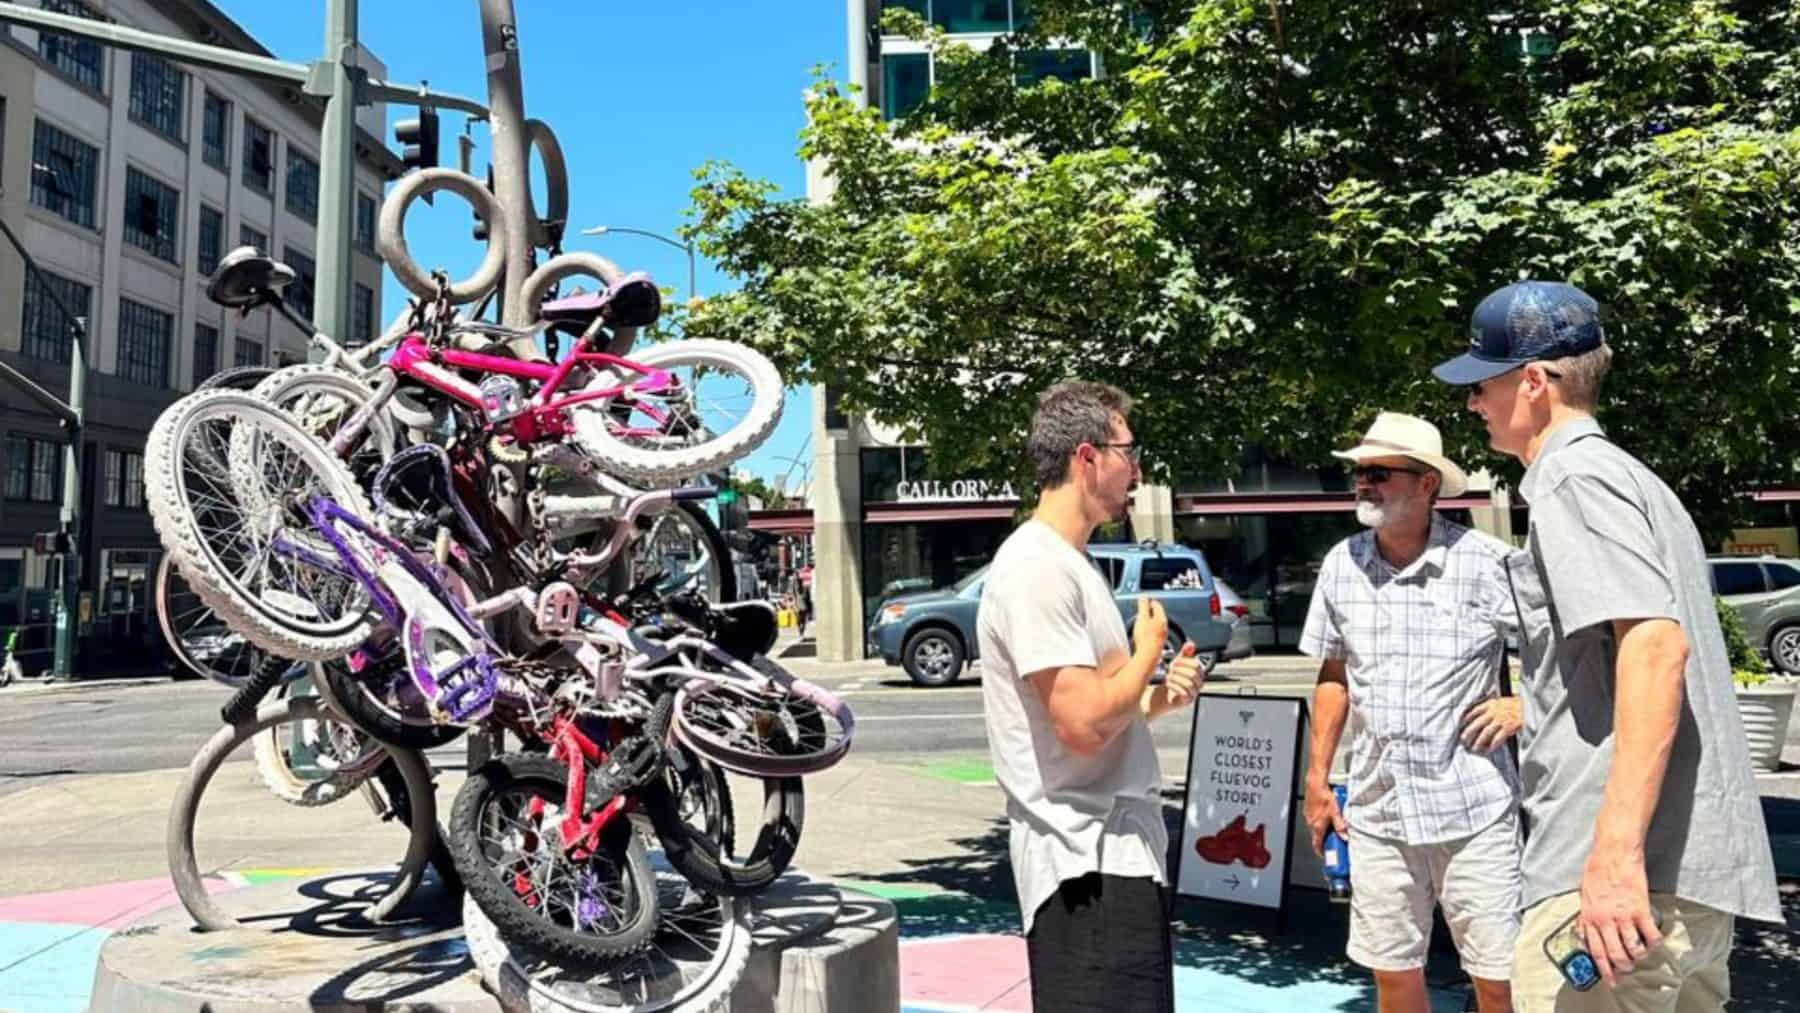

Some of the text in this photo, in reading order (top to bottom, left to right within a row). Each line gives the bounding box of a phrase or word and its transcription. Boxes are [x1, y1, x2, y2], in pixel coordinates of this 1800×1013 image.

[896, 480, 1018, 502] CALIORNA
[1215, 736, 1273, 752] WORLD'S
[1214, 753, 1272, 769] CLOSEST
[1210, 770, 1271, 788] FLUEVOG
